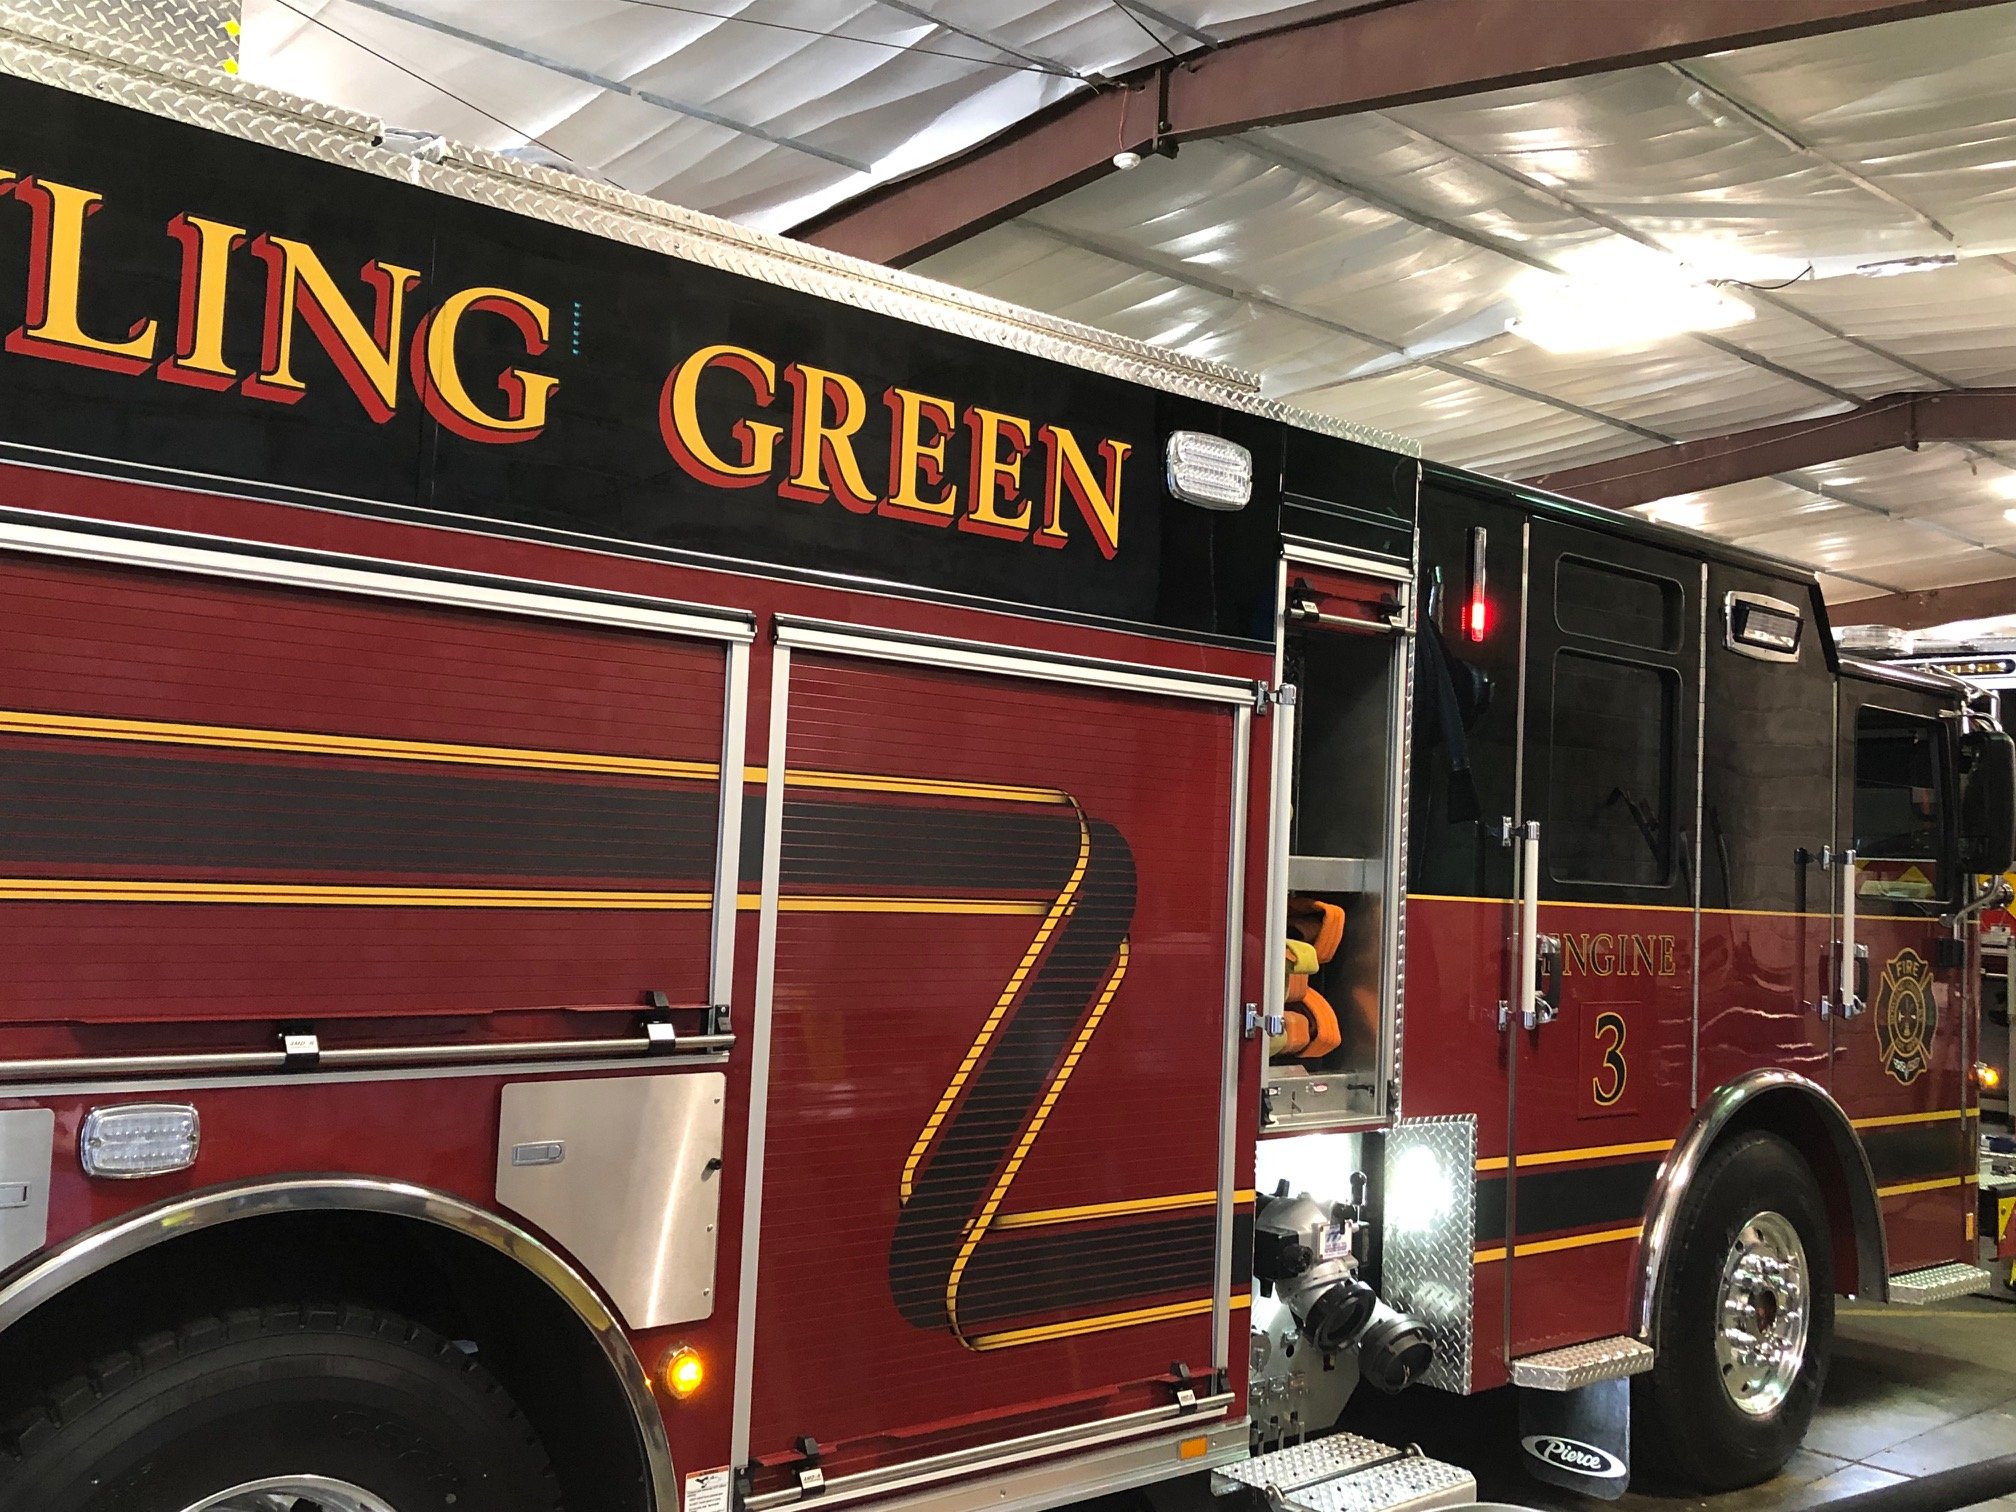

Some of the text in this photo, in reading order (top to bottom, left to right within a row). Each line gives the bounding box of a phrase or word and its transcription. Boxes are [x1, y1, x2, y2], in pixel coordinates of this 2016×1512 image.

[0, 169, 1132, 560] LING GREEN
[1895, 960, 1920, 977] FIRE
[1592, 1011, 1627, 1107] 3
[1543, 1440, 1602, 1470] Pierce
